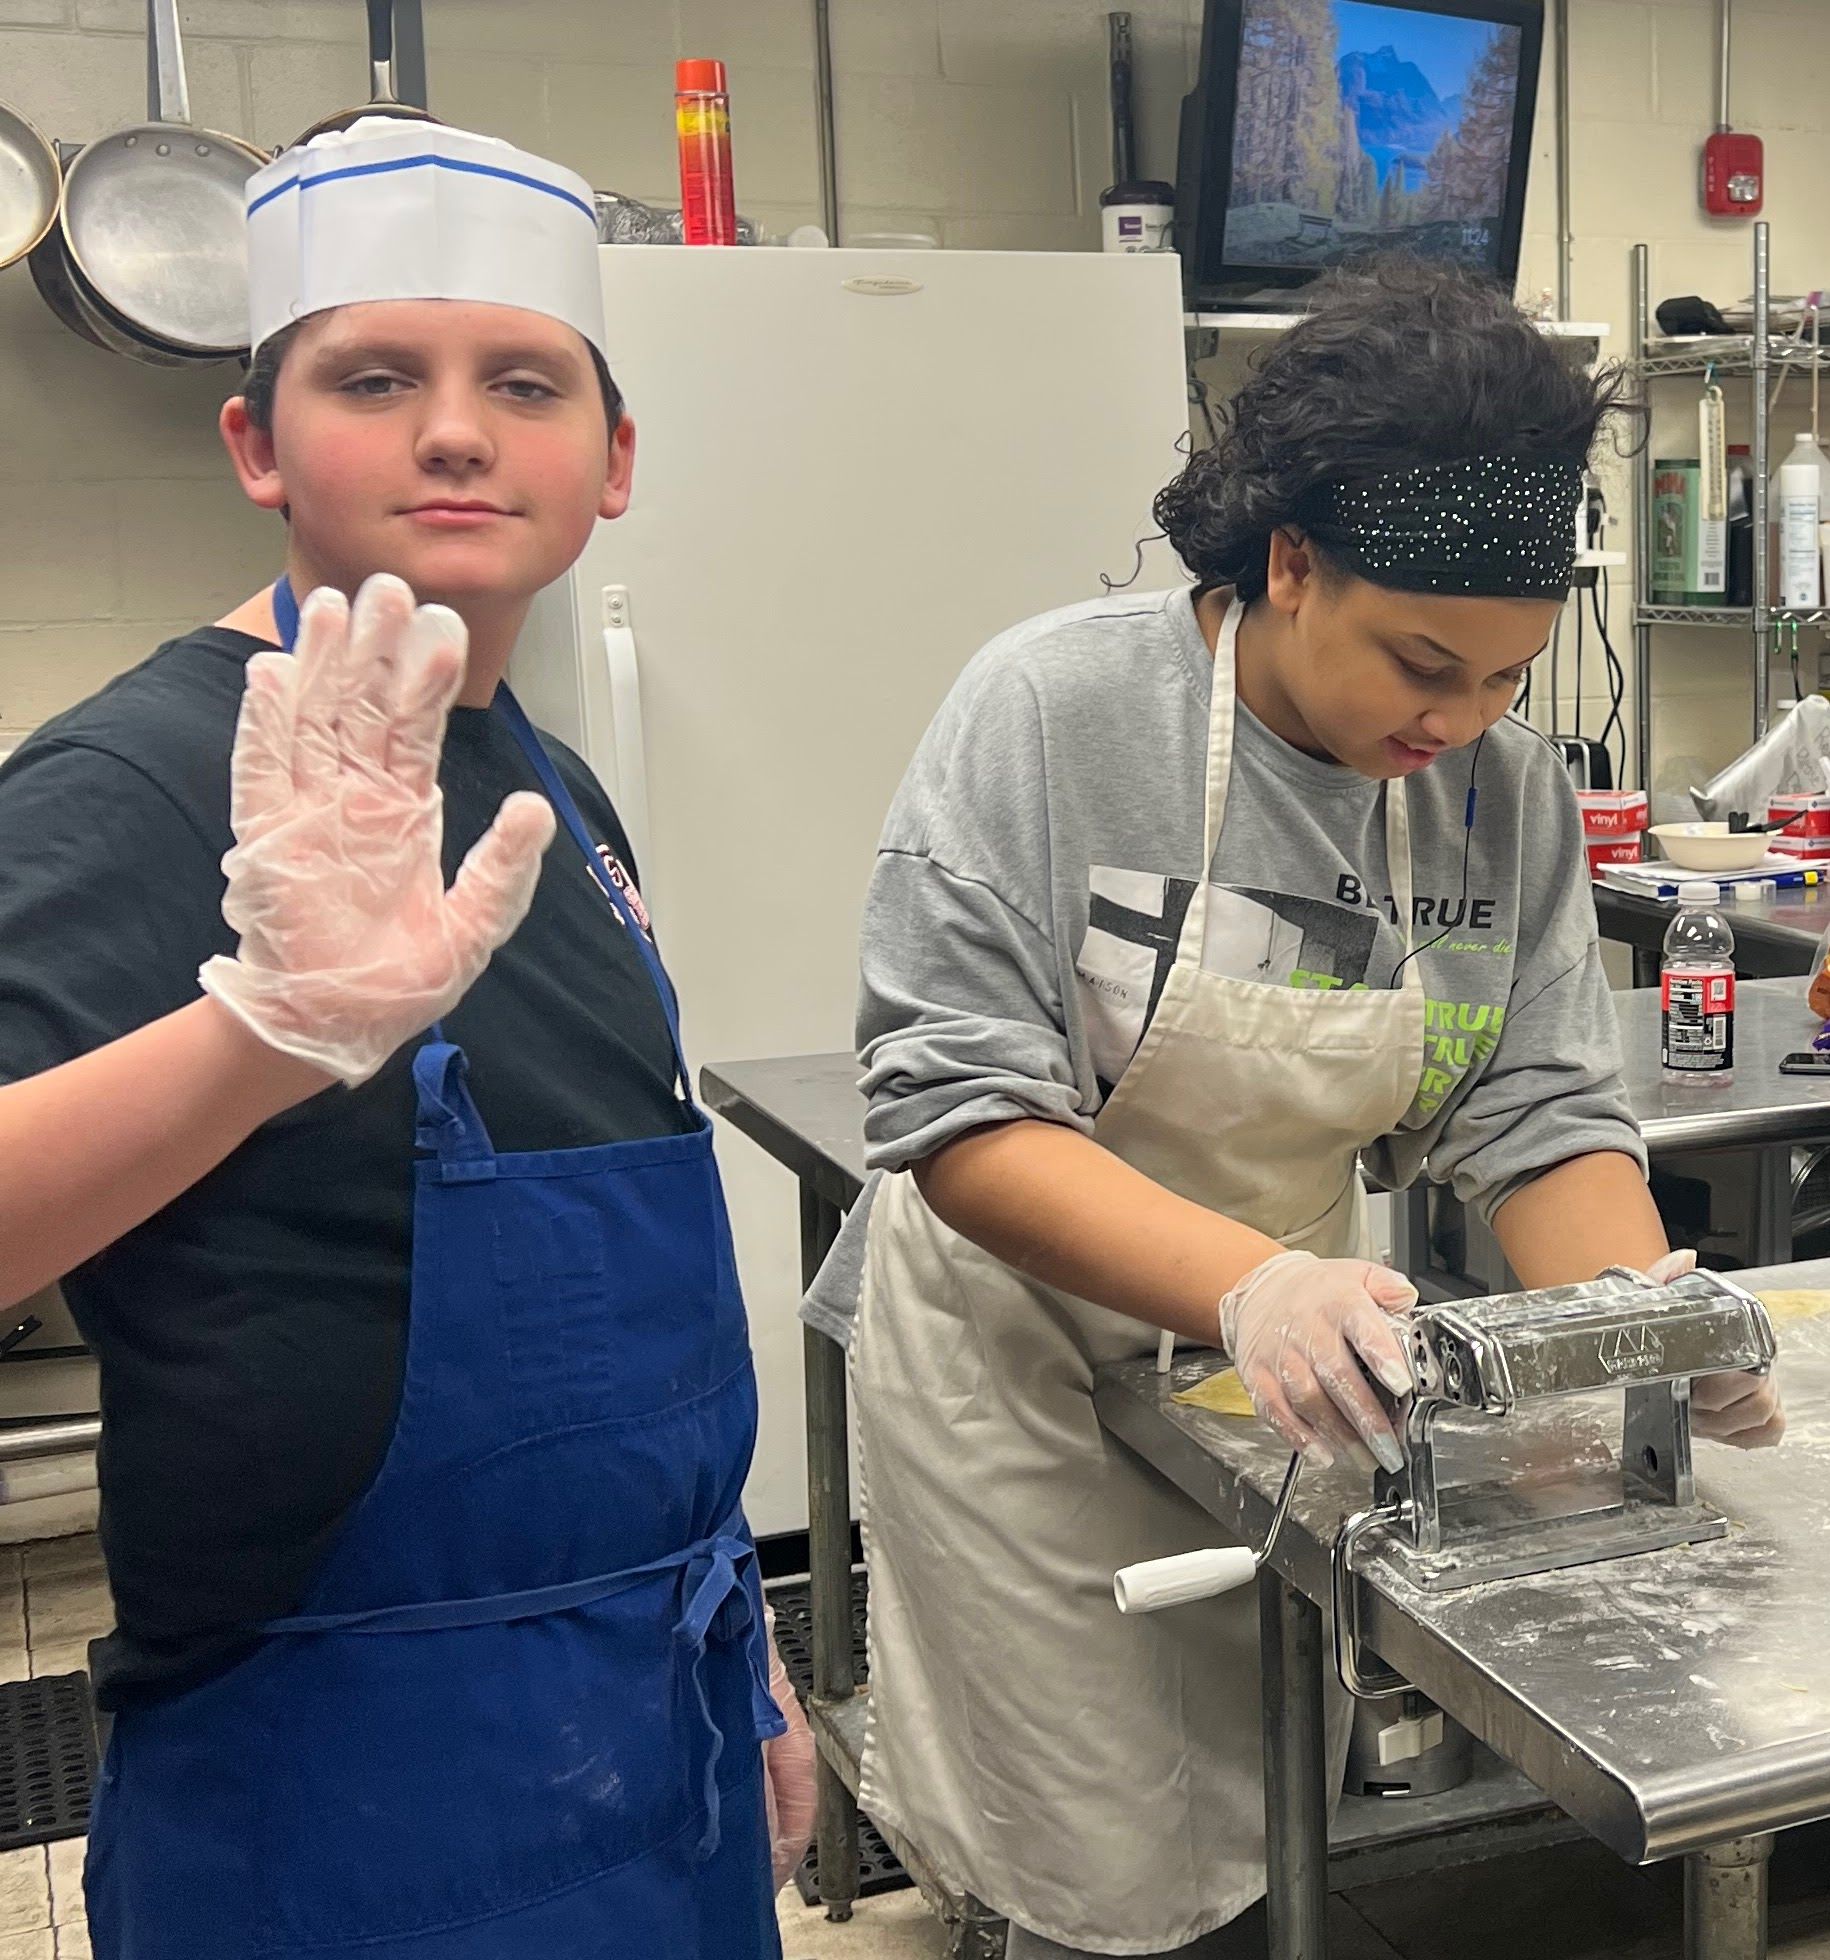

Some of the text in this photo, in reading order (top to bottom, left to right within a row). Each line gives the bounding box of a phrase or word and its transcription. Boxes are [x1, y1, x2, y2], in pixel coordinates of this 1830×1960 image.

[1590, 813, 1618, 828] vinyl
[1611, 846, 1638, 860] vinyl
[1336, 873, 1496, 929] B TRUE
[1449, 943, 1487, 953] never
